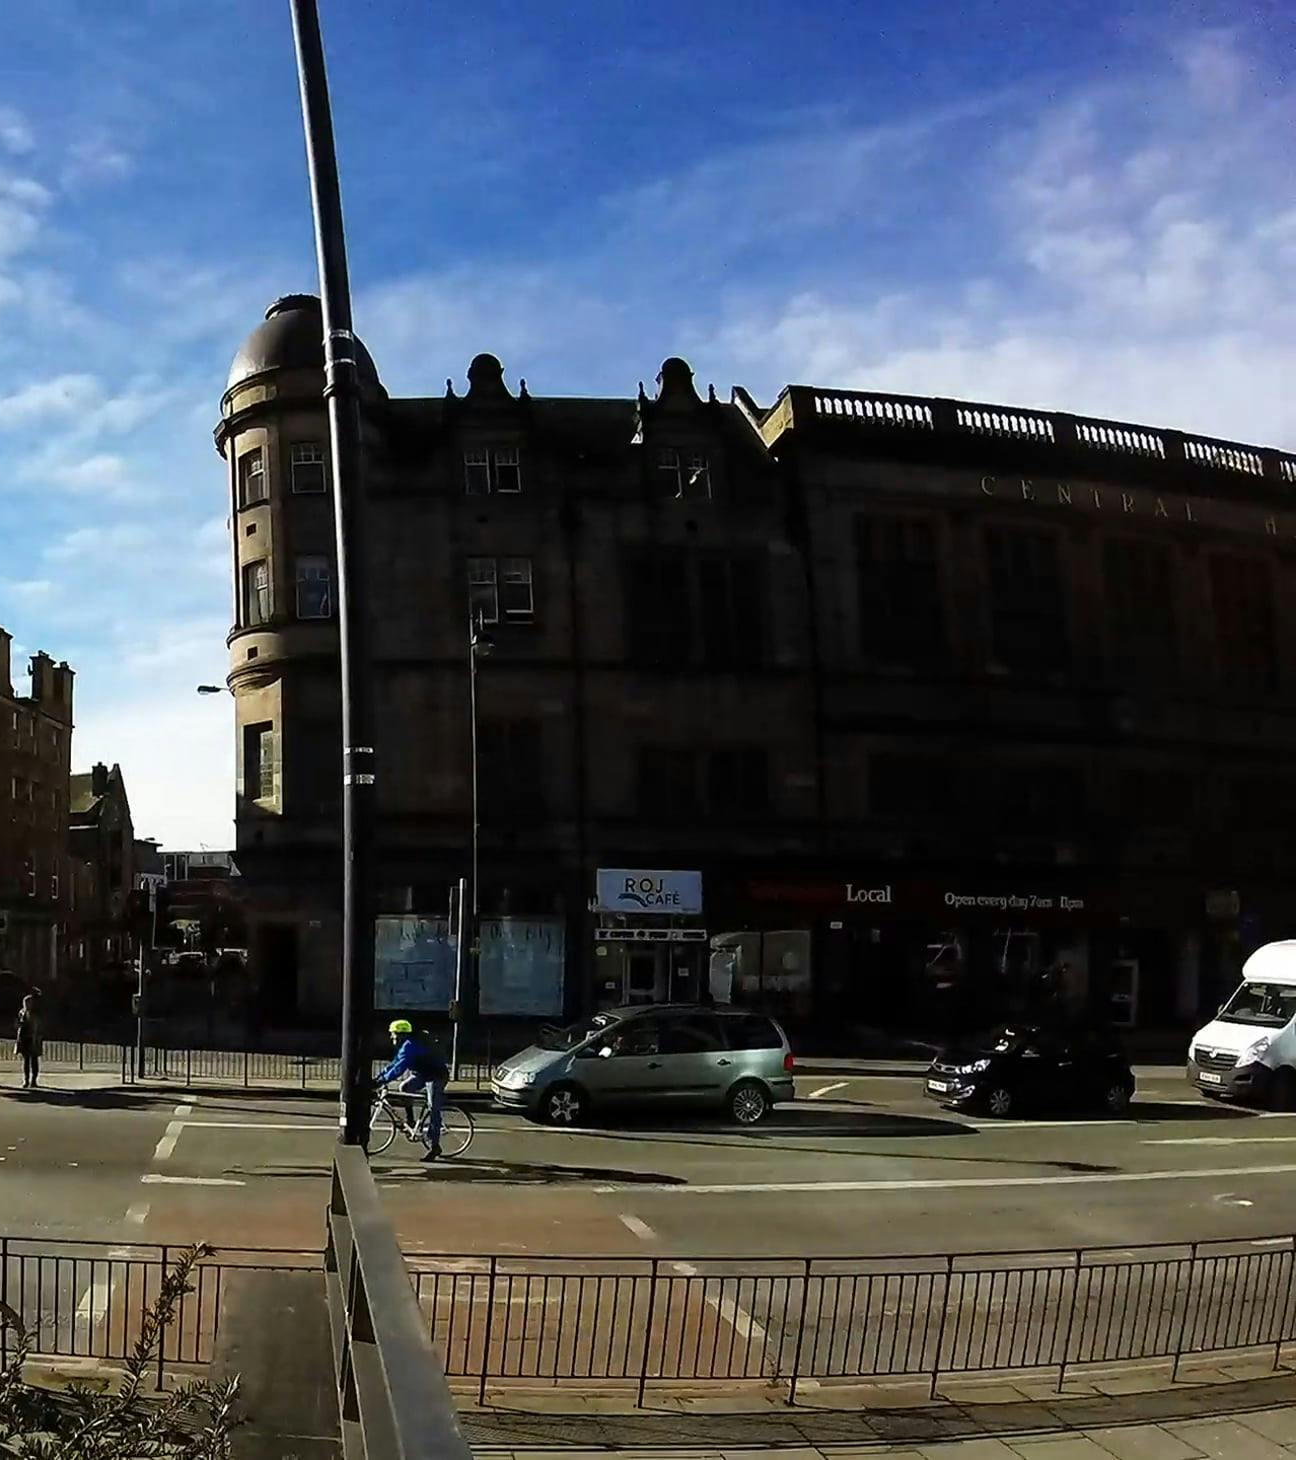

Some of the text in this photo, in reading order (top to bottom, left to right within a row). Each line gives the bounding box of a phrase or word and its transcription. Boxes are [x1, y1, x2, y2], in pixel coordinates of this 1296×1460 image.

[979, 474, 1199, 523] CENTRAL
[625, 878, 664, 893] ROJ
[846, 884, 892, 903] Local
[646, 891, 680, 905] CAFÉ
[944, 892, 976, 909] Open
[977, 895, 1007, 910] every
[1008, 894, 1028, 910] day
